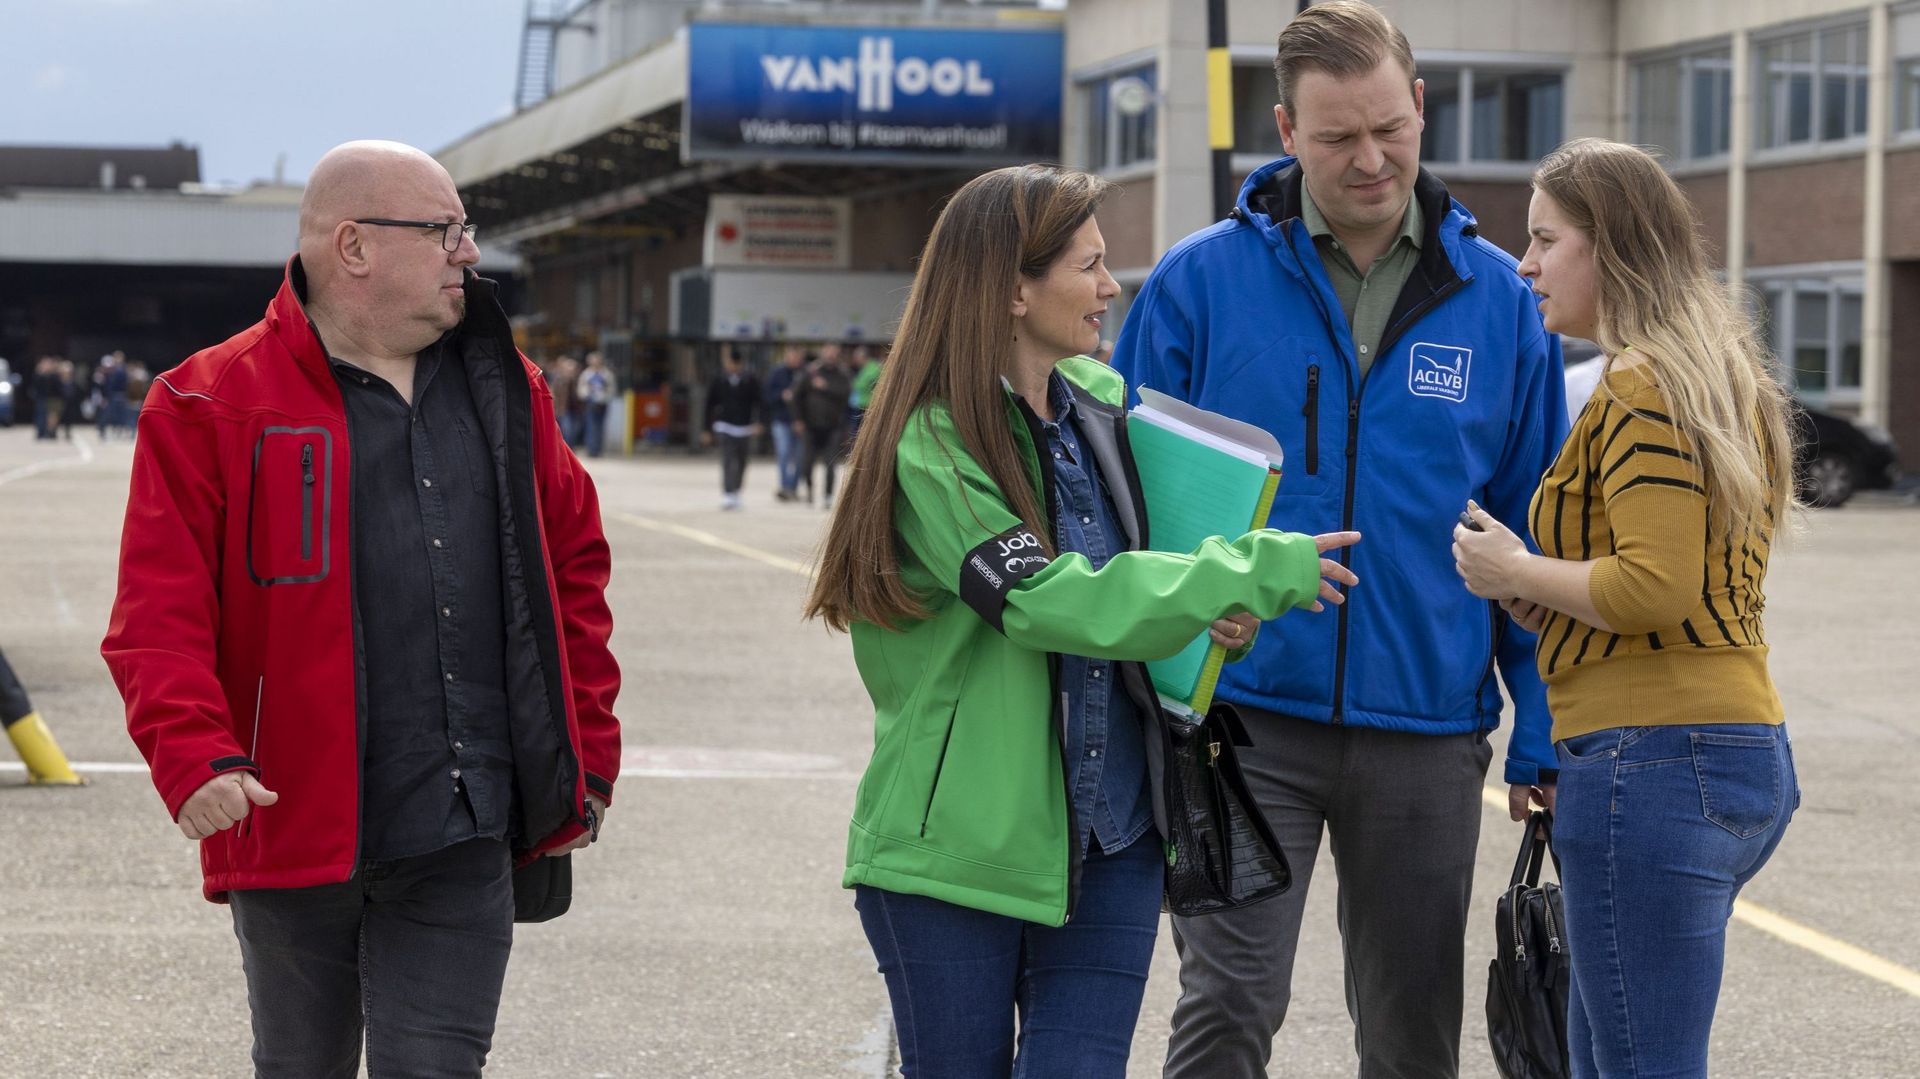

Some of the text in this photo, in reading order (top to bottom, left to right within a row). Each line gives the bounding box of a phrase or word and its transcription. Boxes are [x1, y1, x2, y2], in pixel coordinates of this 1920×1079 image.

[740, 120, 825, 143] Welkom
[829, 121, 854, 148] bij
[1414, 369, 1462, 389] ACLVB
